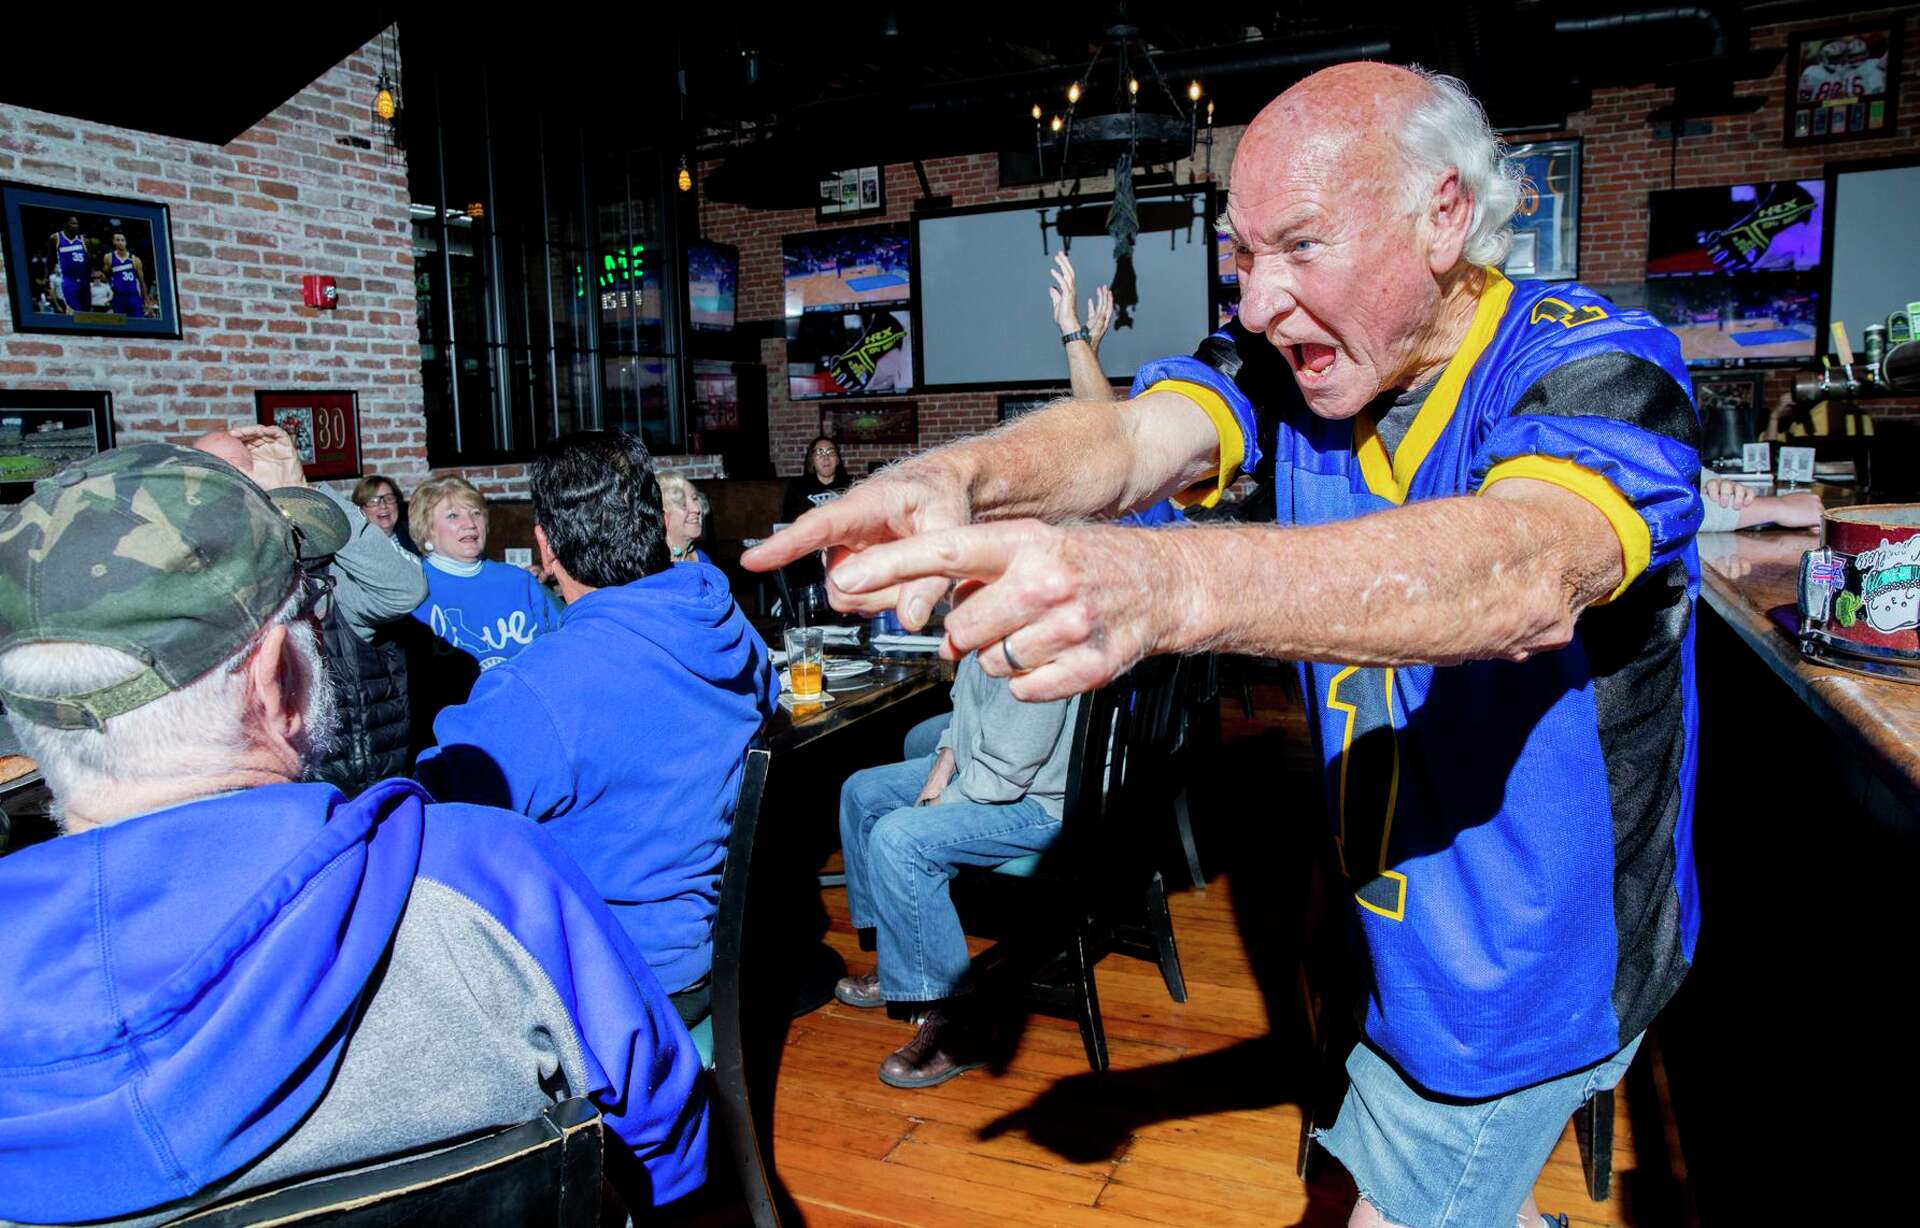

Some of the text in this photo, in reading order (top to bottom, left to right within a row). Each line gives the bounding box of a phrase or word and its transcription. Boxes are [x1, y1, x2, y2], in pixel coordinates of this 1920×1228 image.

[71, 252, 85, 263] 35
[122, 271, 134, 281] 30
[317, 406, 346, 450] 80
